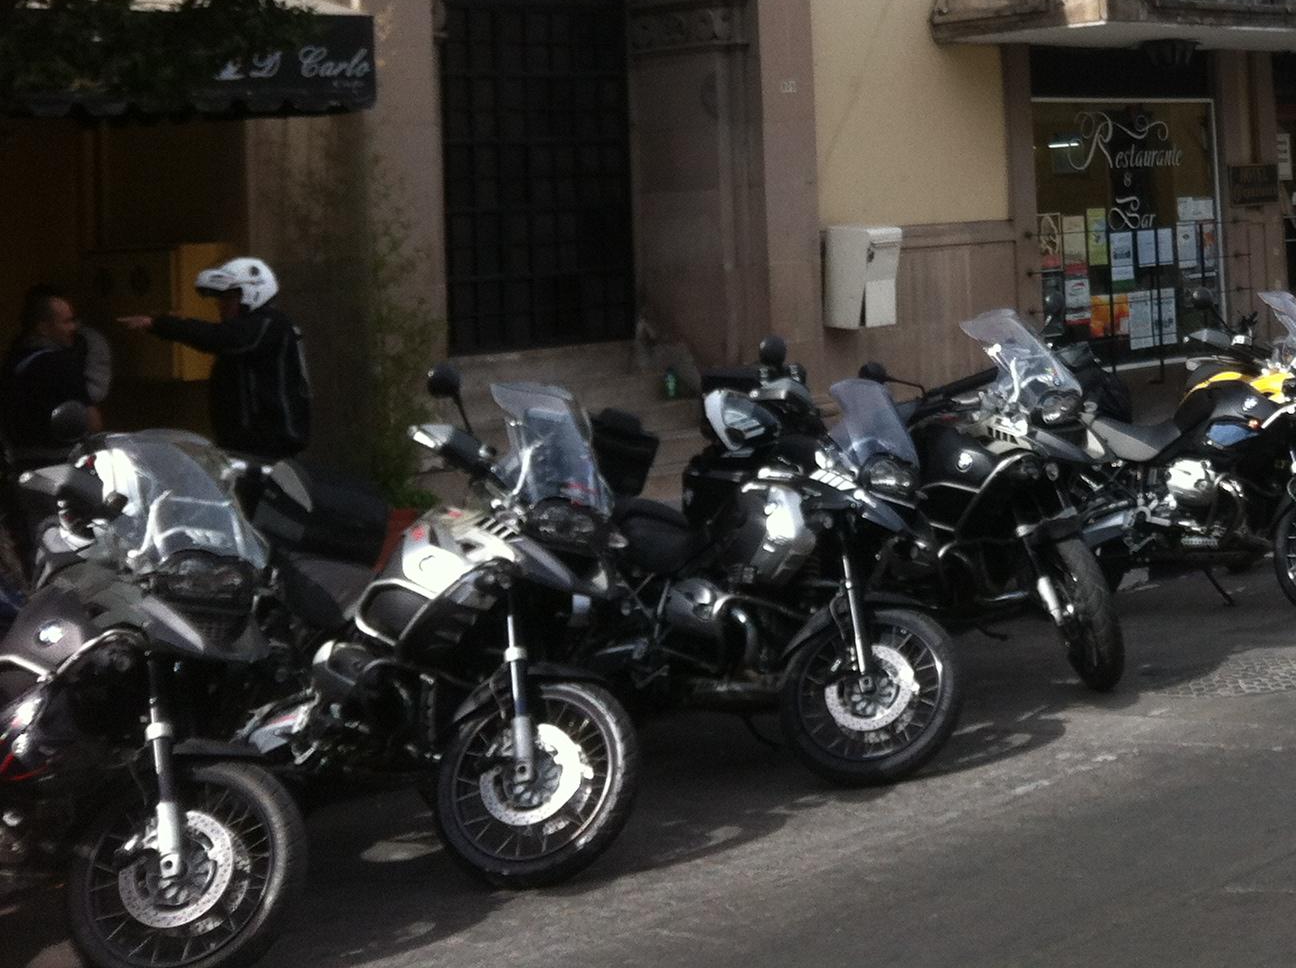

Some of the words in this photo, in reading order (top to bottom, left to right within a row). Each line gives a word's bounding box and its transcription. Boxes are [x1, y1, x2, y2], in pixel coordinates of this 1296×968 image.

[299, 45, 371, 78] Carlo
[1067, 111, 1182, 170] Restaurante
[1108, 196, 1156, 231] Bar
